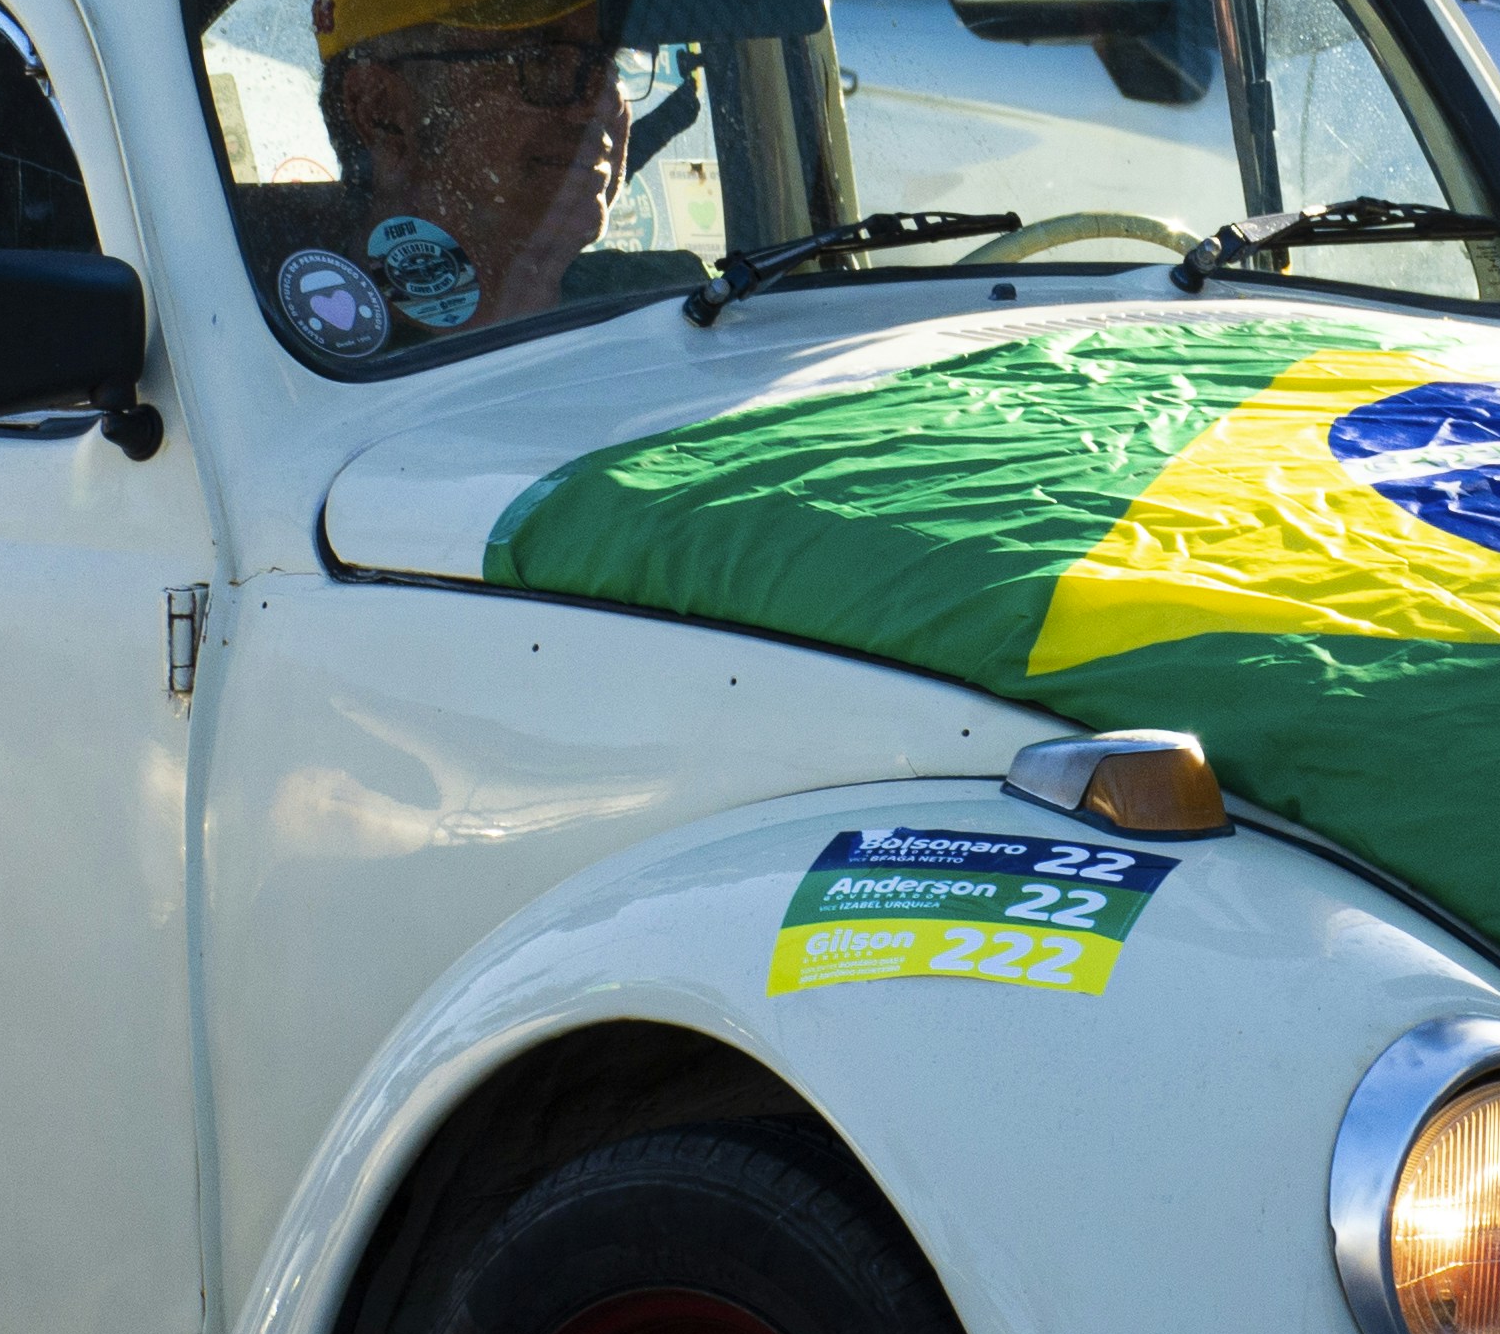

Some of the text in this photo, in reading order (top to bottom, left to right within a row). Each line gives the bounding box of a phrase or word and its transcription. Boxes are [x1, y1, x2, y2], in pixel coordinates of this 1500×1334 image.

[859, 836, 1136, 882] Bolsonaro 22
[918, 855, 965, 864] NETTO
[823, 893, 949, 901] GOVERNADOR
[826, 875, 1108, 929] Anderson 22
[839, 900, 882, 910] IZABEL
[884, 899, 941, 909] URQUIZA
[805, 928, 916, 956] Gilson
[929, 927, 1084, 985] 222
